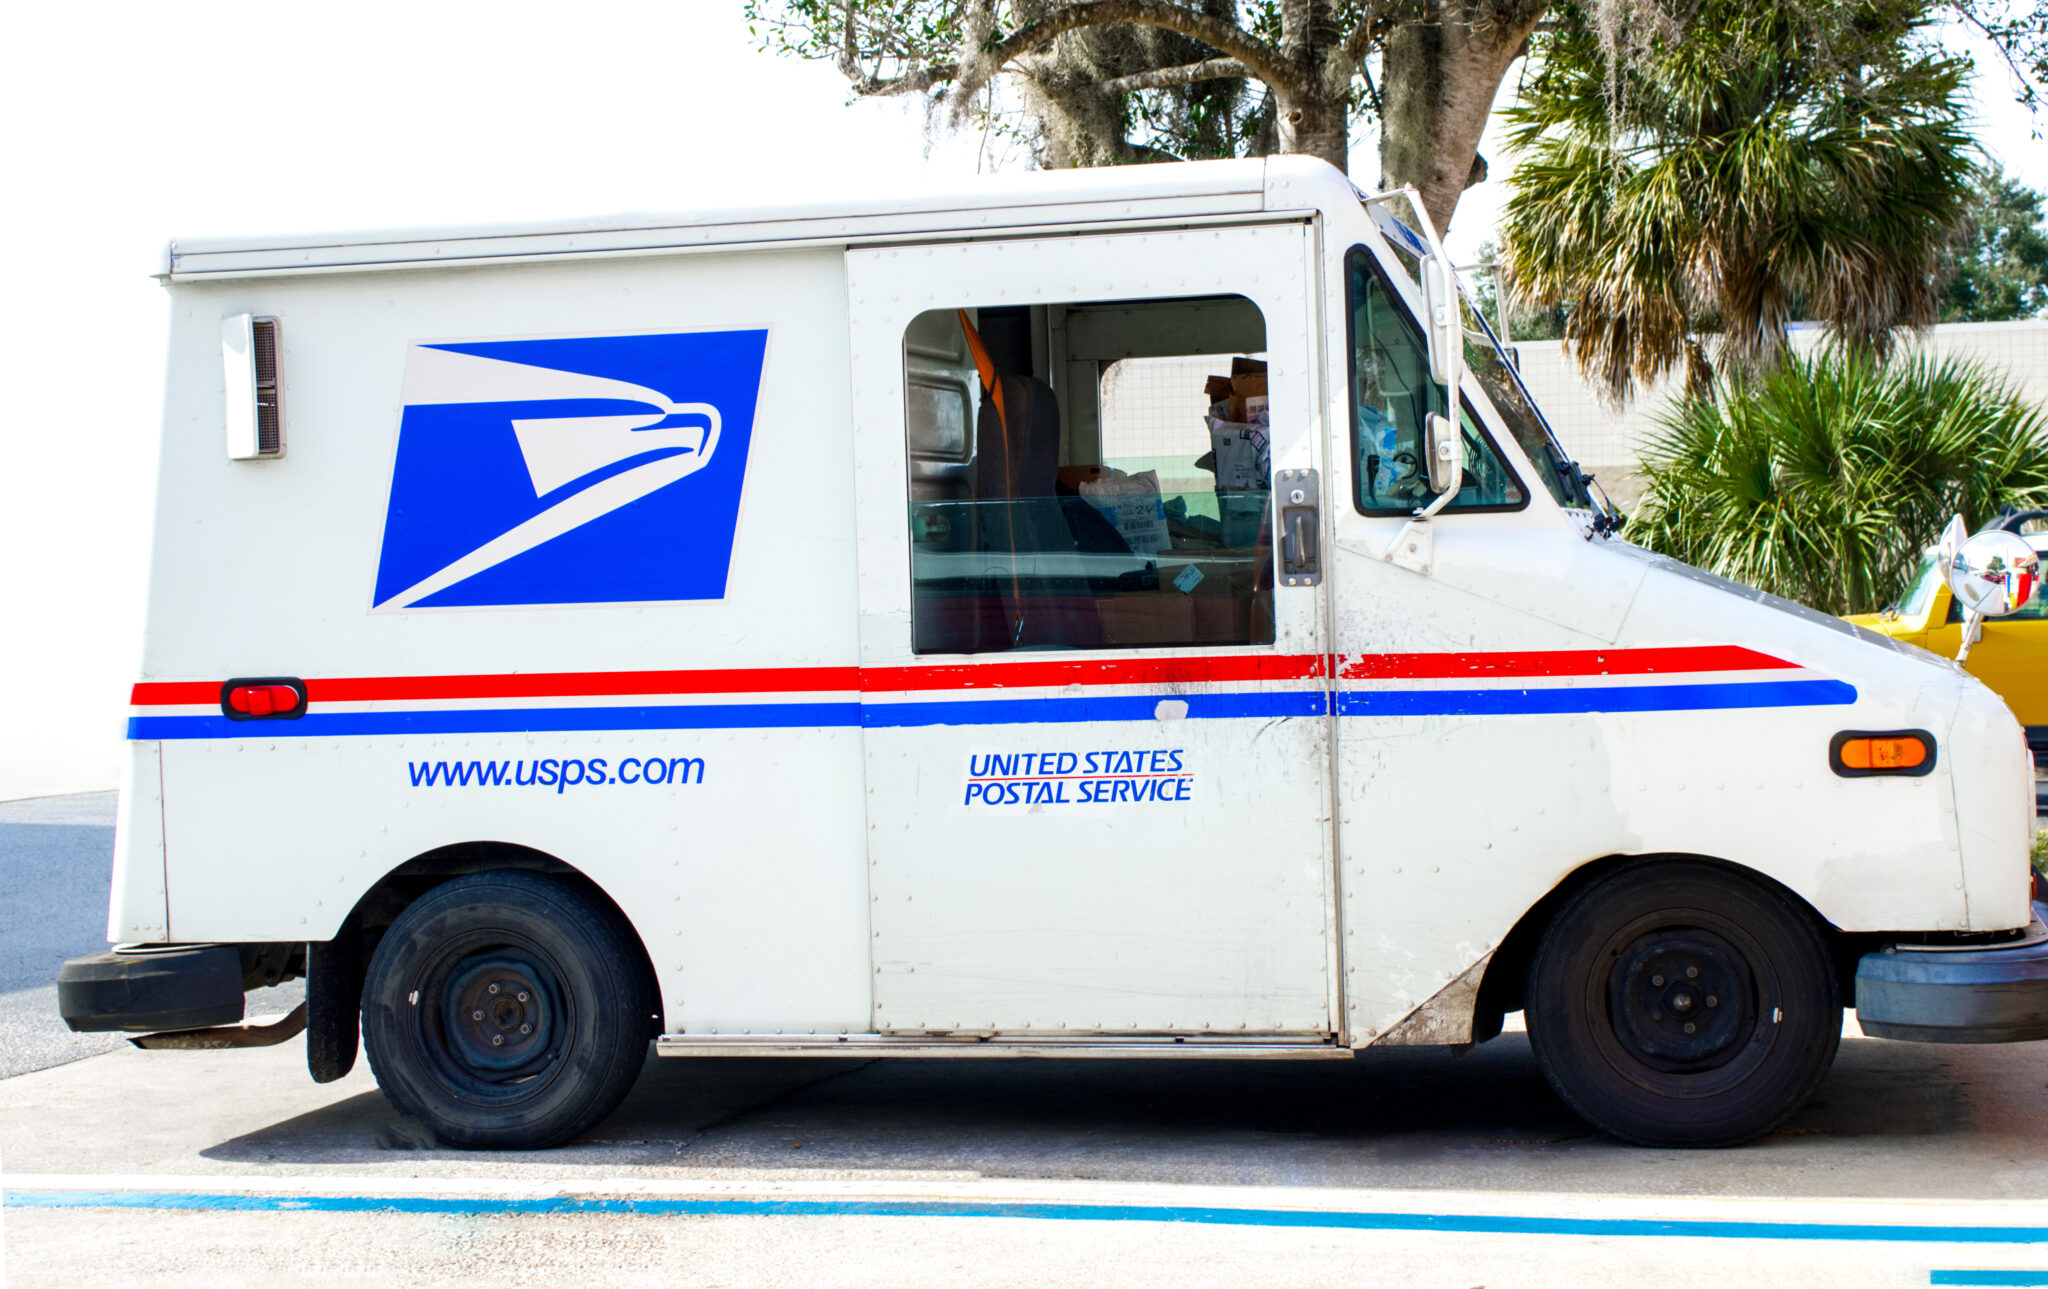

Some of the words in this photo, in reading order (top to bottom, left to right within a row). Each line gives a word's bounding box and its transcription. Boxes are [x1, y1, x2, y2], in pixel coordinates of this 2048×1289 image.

[408, 757, 705, 794] www.usps.com
[969, 753, 1078, 777] UNITED
[1083, 749, 1184, 774] STATES
[964, 781, 1071, 806] POSTAL
[1076, 778, 1194, 804] SERVICE
